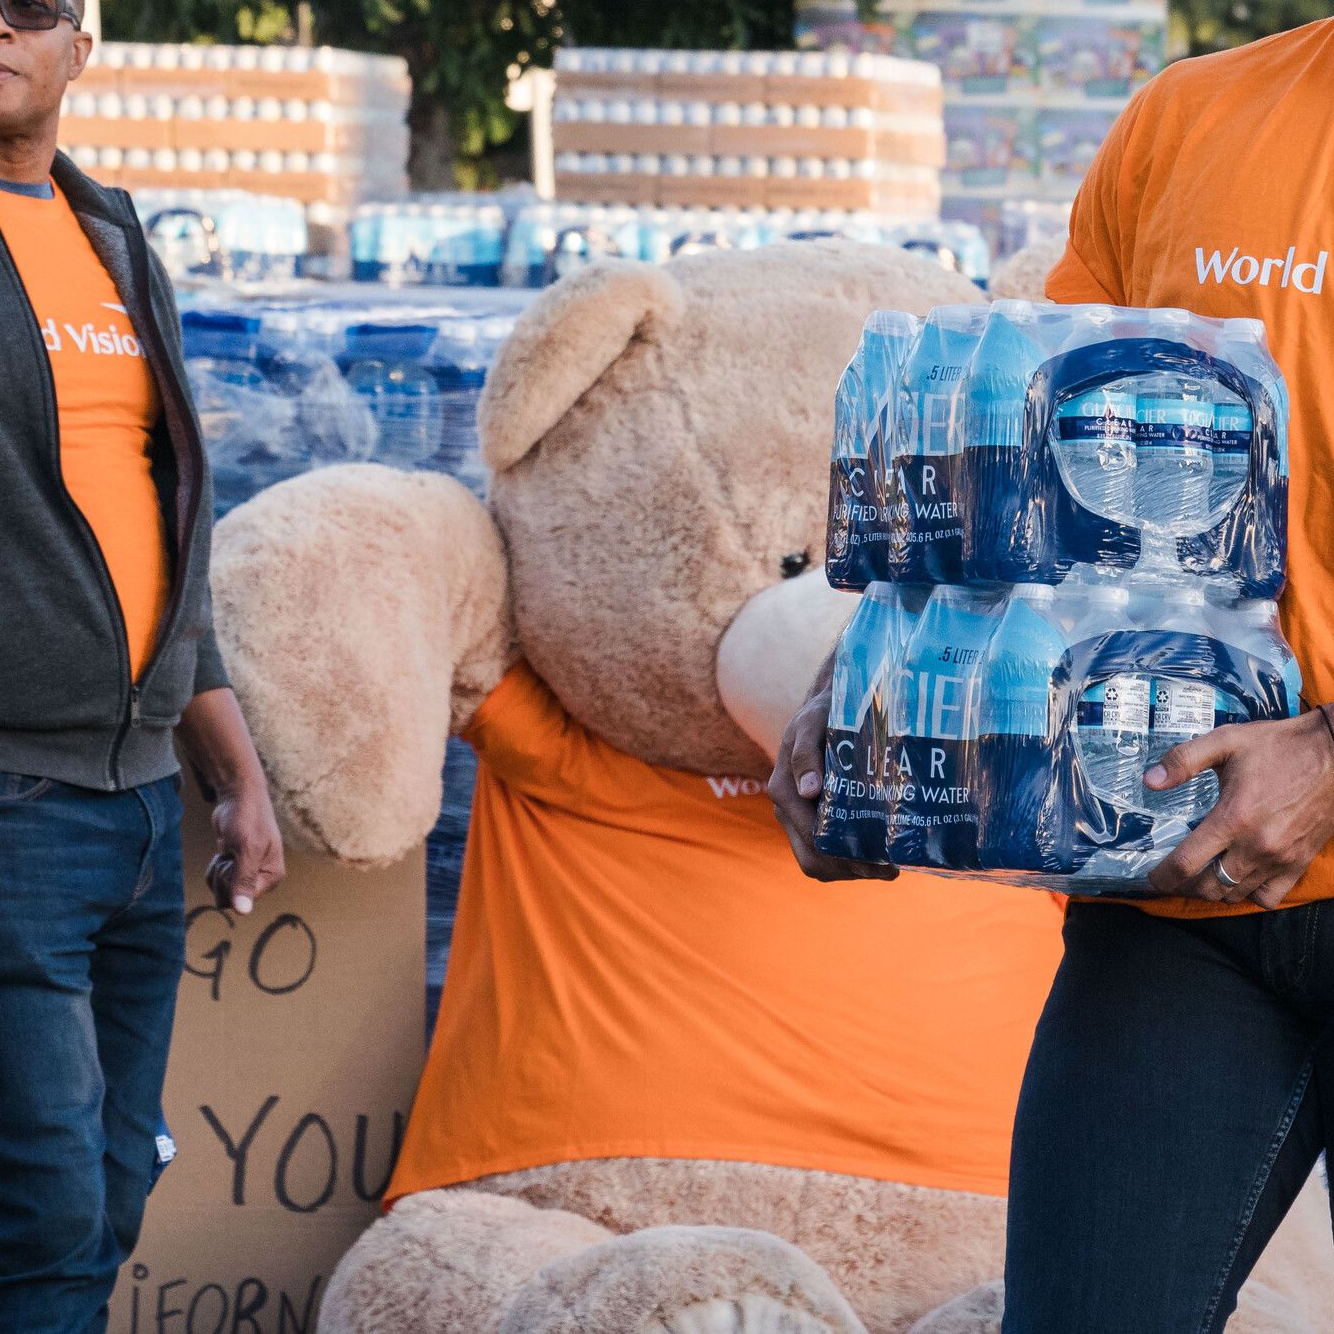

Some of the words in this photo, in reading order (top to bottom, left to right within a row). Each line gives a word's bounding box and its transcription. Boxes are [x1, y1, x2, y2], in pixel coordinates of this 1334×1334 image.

[1194, 246, 1329, 295] World
[64, 322, 147, 358] Visio
[926, 365, 938, 380] .5
[939, 367, 962, 381] LITER
[915, 501, 958, 520] WATER
[924, 532, 933, 542] FL
[938, 646, 950, 662] .5
[953, 649, 979, 664] LITER
[836, 740, 946, 779] CLEAR
[869, 783, 916, 801] DRINKING
[921, 785, 970, 804] WATER
[933, 814, 941, 825] FL
[943, 813, 952, 823] OZ
[199, 1095, 408, 1213] YOU
